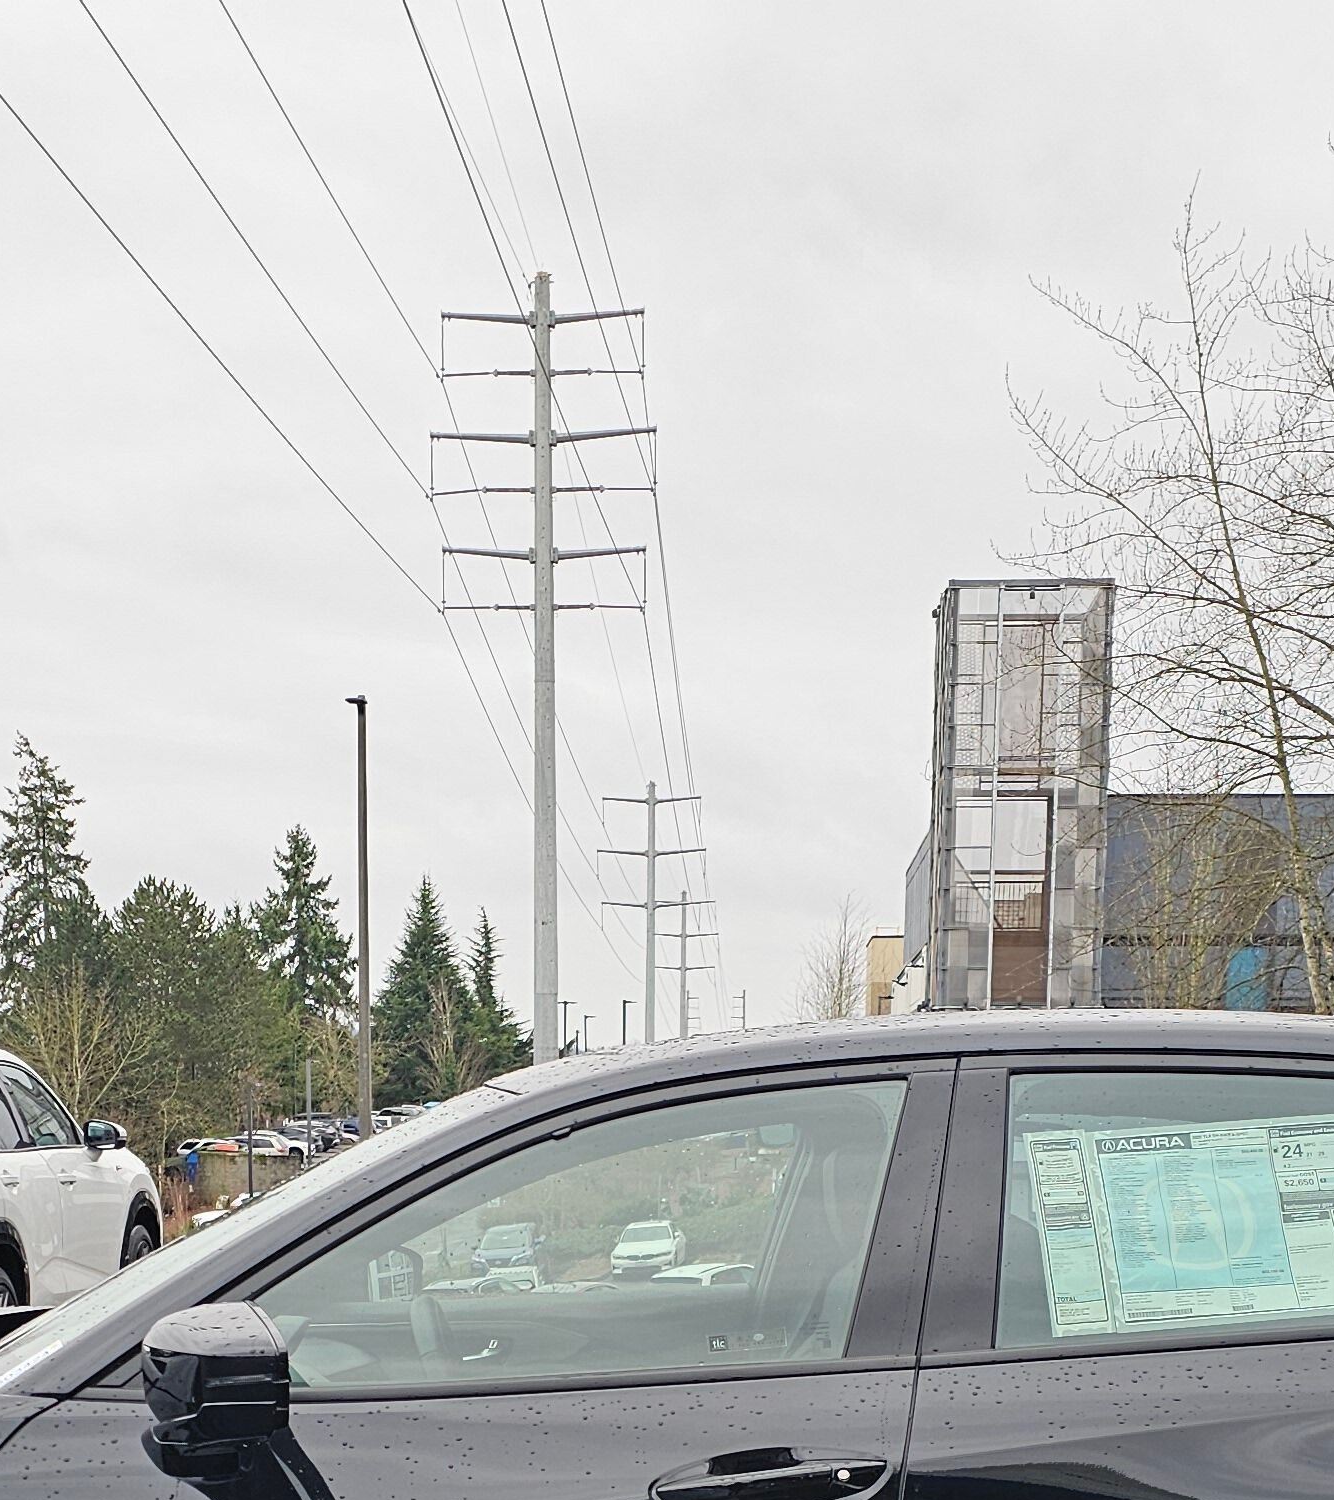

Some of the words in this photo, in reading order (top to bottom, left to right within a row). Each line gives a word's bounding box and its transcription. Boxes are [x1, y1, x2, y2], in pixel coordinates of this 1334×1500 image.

[1117, 1136, 1185, 1150] ACURA
[1281, 1143, 1304, 1158] 24
[1284, 1178, 1315, 1187] $2,650
[712, 1338, 725, 1349] tlc
